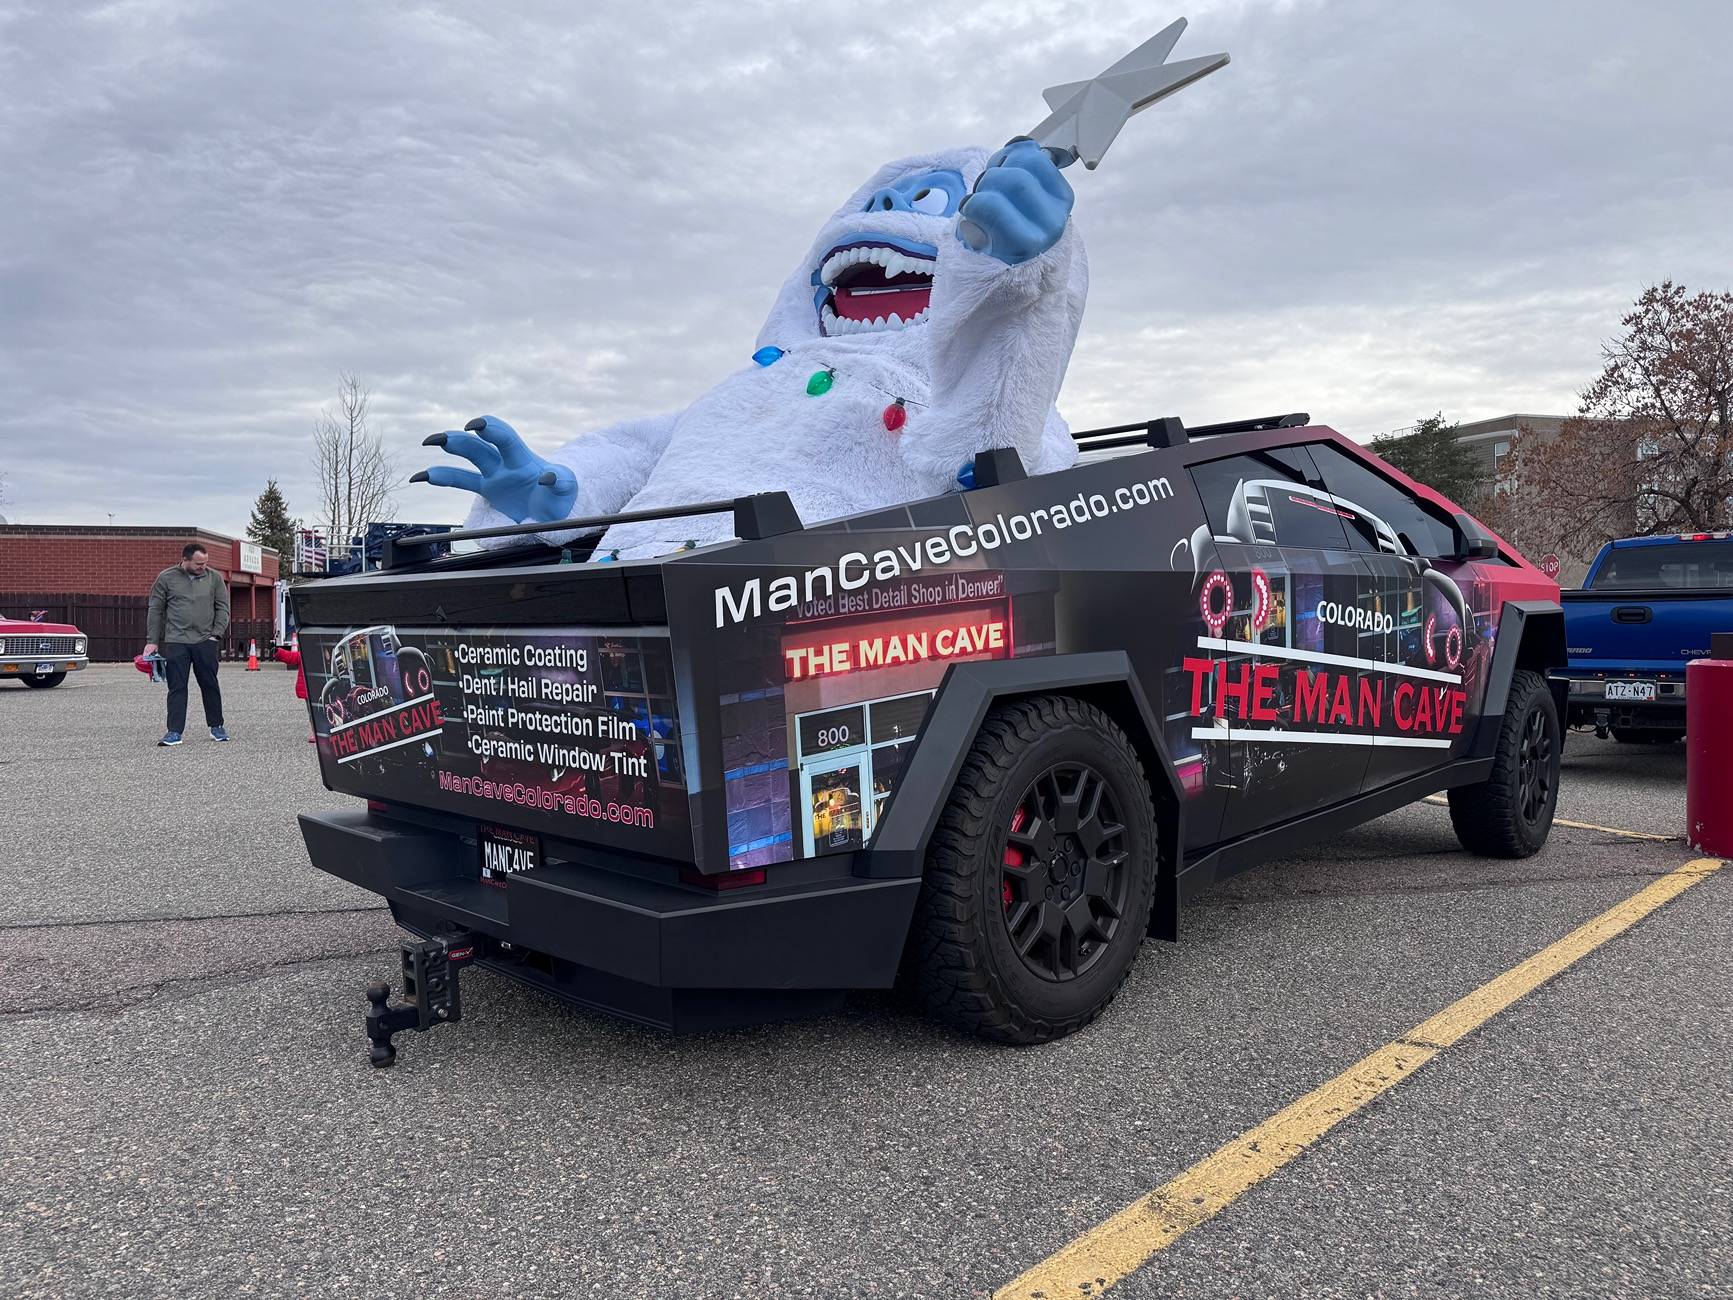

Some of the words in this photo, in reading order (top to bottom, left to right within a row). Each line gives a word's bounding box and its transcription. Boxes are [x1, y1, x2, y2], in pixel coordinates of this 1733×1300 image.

[714, 476, 1173, 628] ManCaveColorado.com
[1541, 562, 1558, 573] STOP
[839, 589, 869, 615] Best
[872, 584, 908, 609] Detail
[911, 582, 943, 606] Shop
[945, 578, 956, 600] in
[1316, 600, 1393, 635] COLORADO
[458, 643, 520, 666] Ceramic
[524, 644, 588, 672] Coating
[786, 642, 850, 679] THE
[858, 632, 928, 668] MAN
[935, 622, 1004, 656] CAVE
[356, 684, 389, 706] COLORADO
[463, 677, 496, 697] Dent
[499, 678, 505, 697] /
[508, 680, 537, 700] Hail
[541, 680, 598, 705] Repair
[1183, 656, 1280, 722] THE
[1293, 670, 1383, 728] MAN
[1394, 682, 1467, 735] CAVE
[329, 730, 359, 758] THE
[359, 716, 396, 748] MAN
[399, 700, 446, 737] CAVE
[468, 706, 504, 728] Paint
[508, 708, 594, 738] Protection
[597, 715, 637, 742] Film
[817, 725, 849, 747] 800
[472, 734, 534, 763] Ceramic
[538, 742, 606, 772] Window
[610, 751, 648, 778] Tint
[438, 770, 655, 829] ManCaveColorado.com
